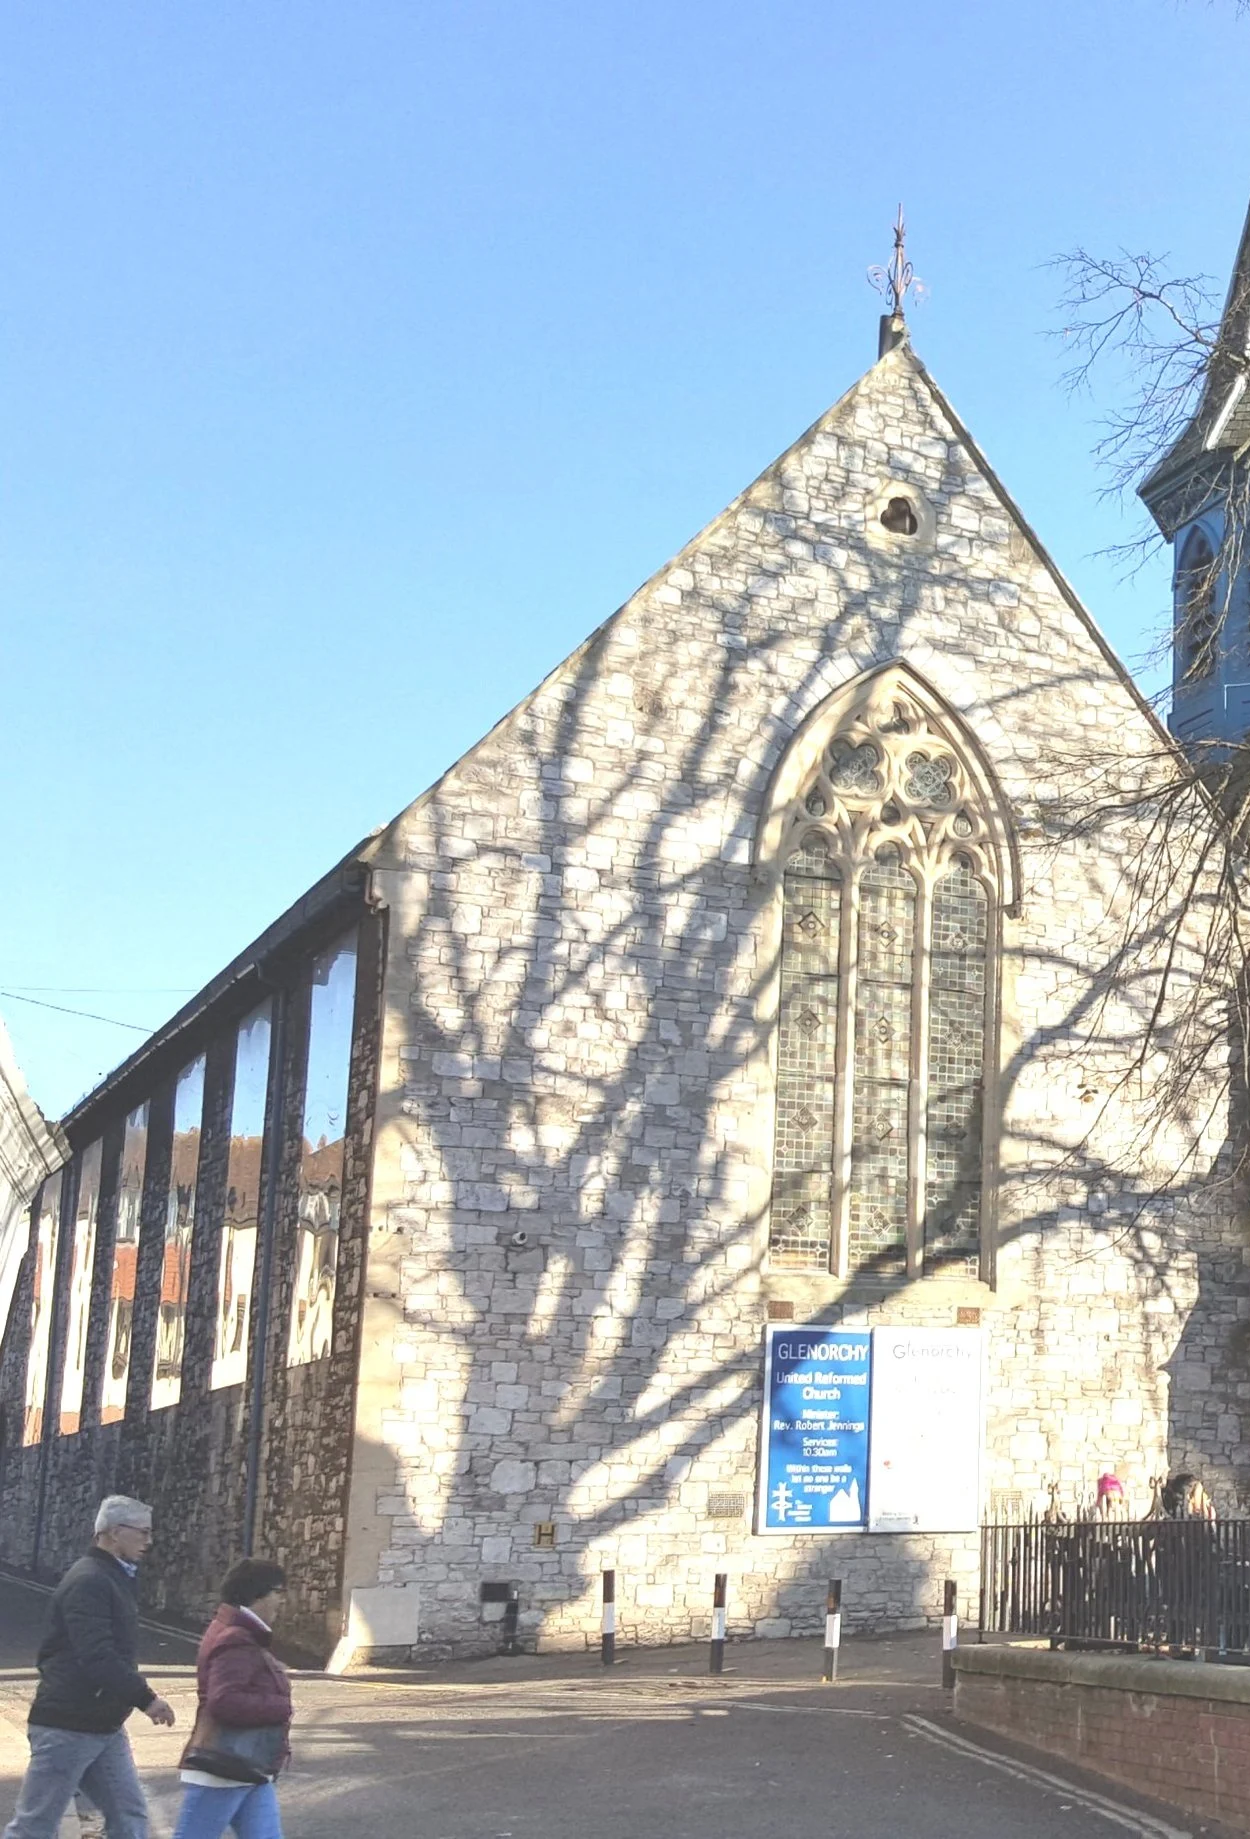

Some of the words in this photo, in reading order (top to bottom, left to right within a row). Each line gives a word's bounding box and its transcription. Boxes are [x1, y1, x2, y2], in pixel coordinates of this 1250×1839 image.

[778, 1343, 869, 1361] GLENORCHY
[776, 1371, 812, 1384] United
[814, 1371, 867, 1385] Reformed
[802, 1386, 841, 1400] Church
[773, 1419, 793, 1430] Rev.
[795, 1420, 825, 1431] Robert
[827, 1420, 864, 1433] Jennings
